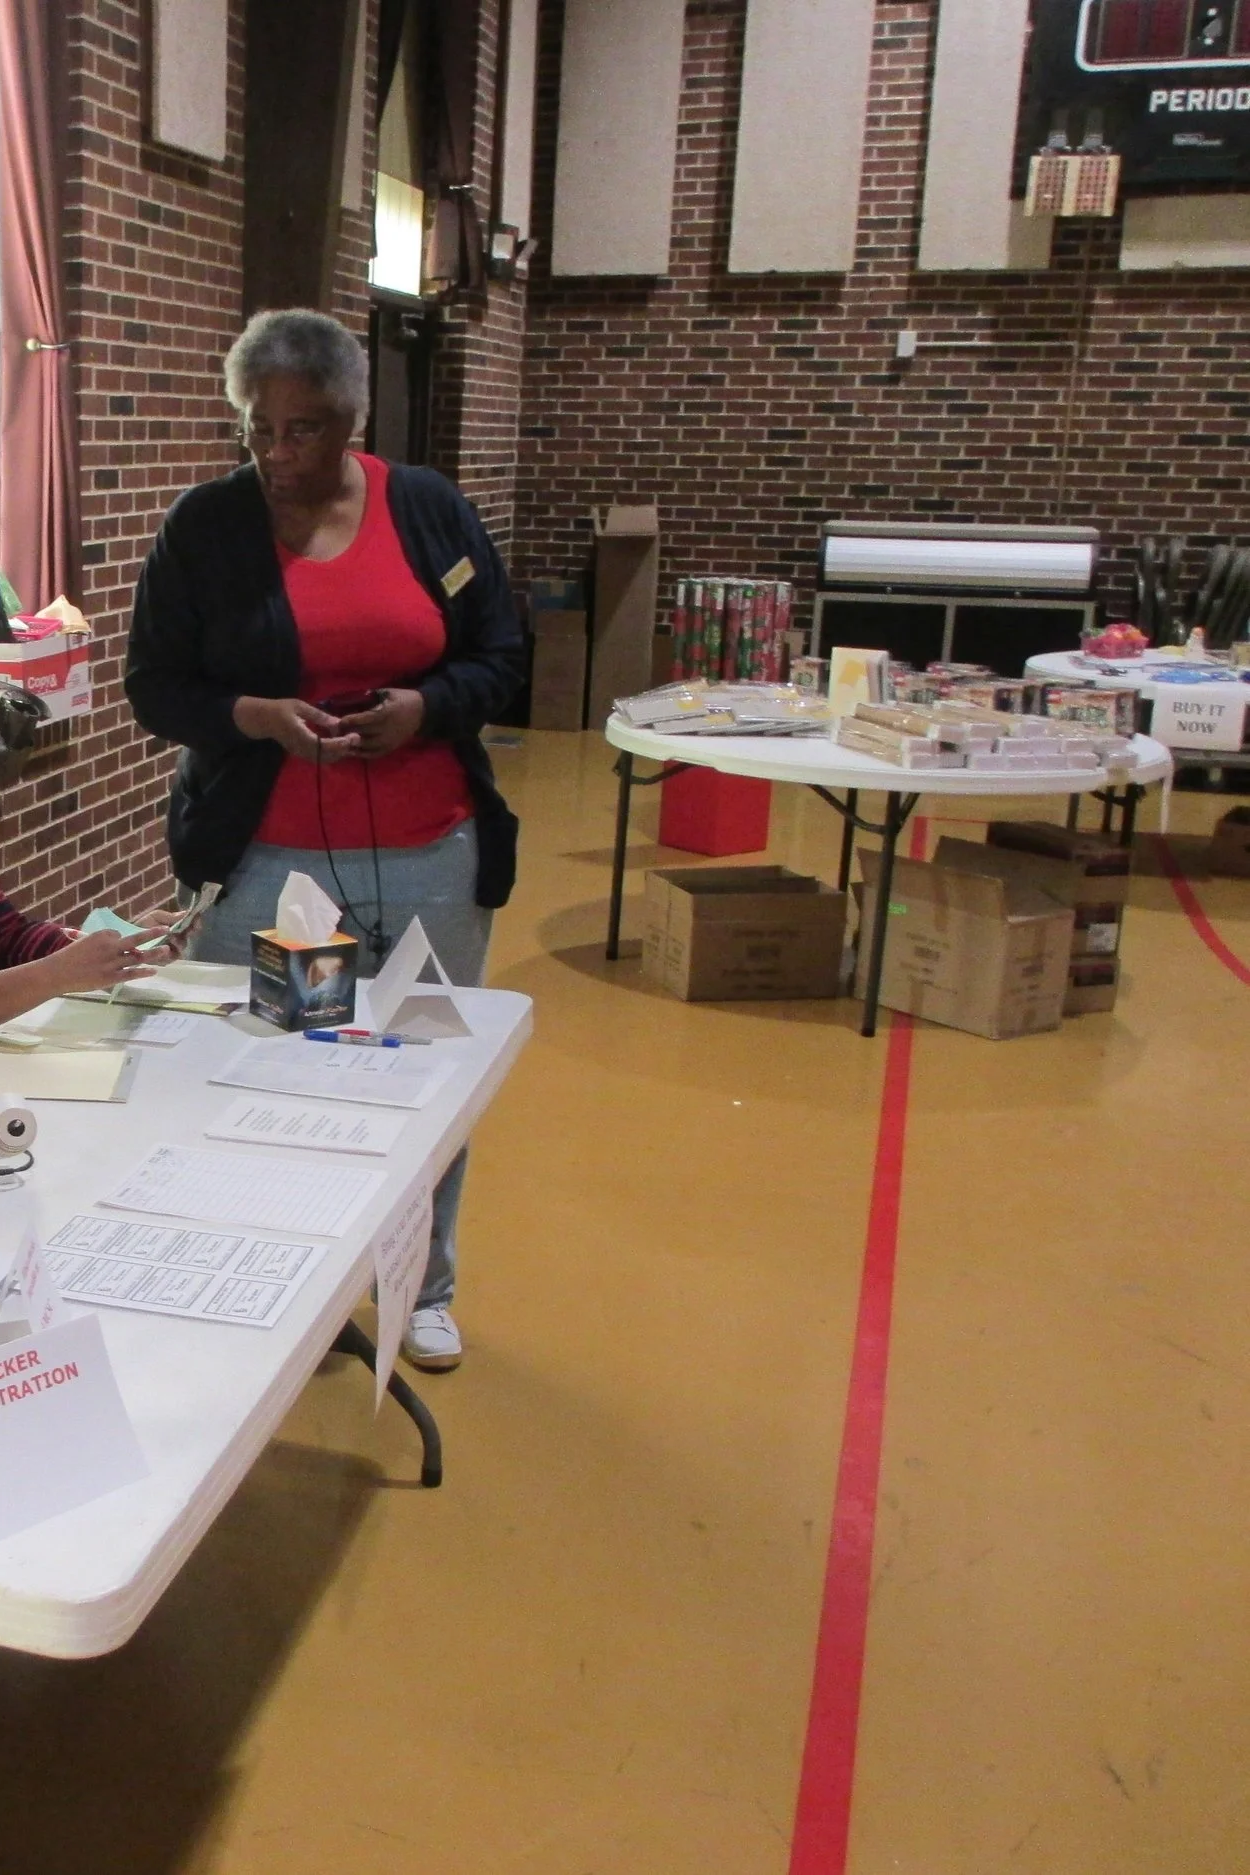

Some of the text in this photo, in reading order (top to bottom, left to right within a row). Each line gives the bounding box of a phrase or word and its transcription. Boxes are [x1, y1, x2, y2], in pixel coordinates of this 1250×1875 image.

[1149, 87, 1250, 112] PERIOD
[1173, 701, 1226, 716] BUY IT
[1176, 719, 1218, 734] NOW
